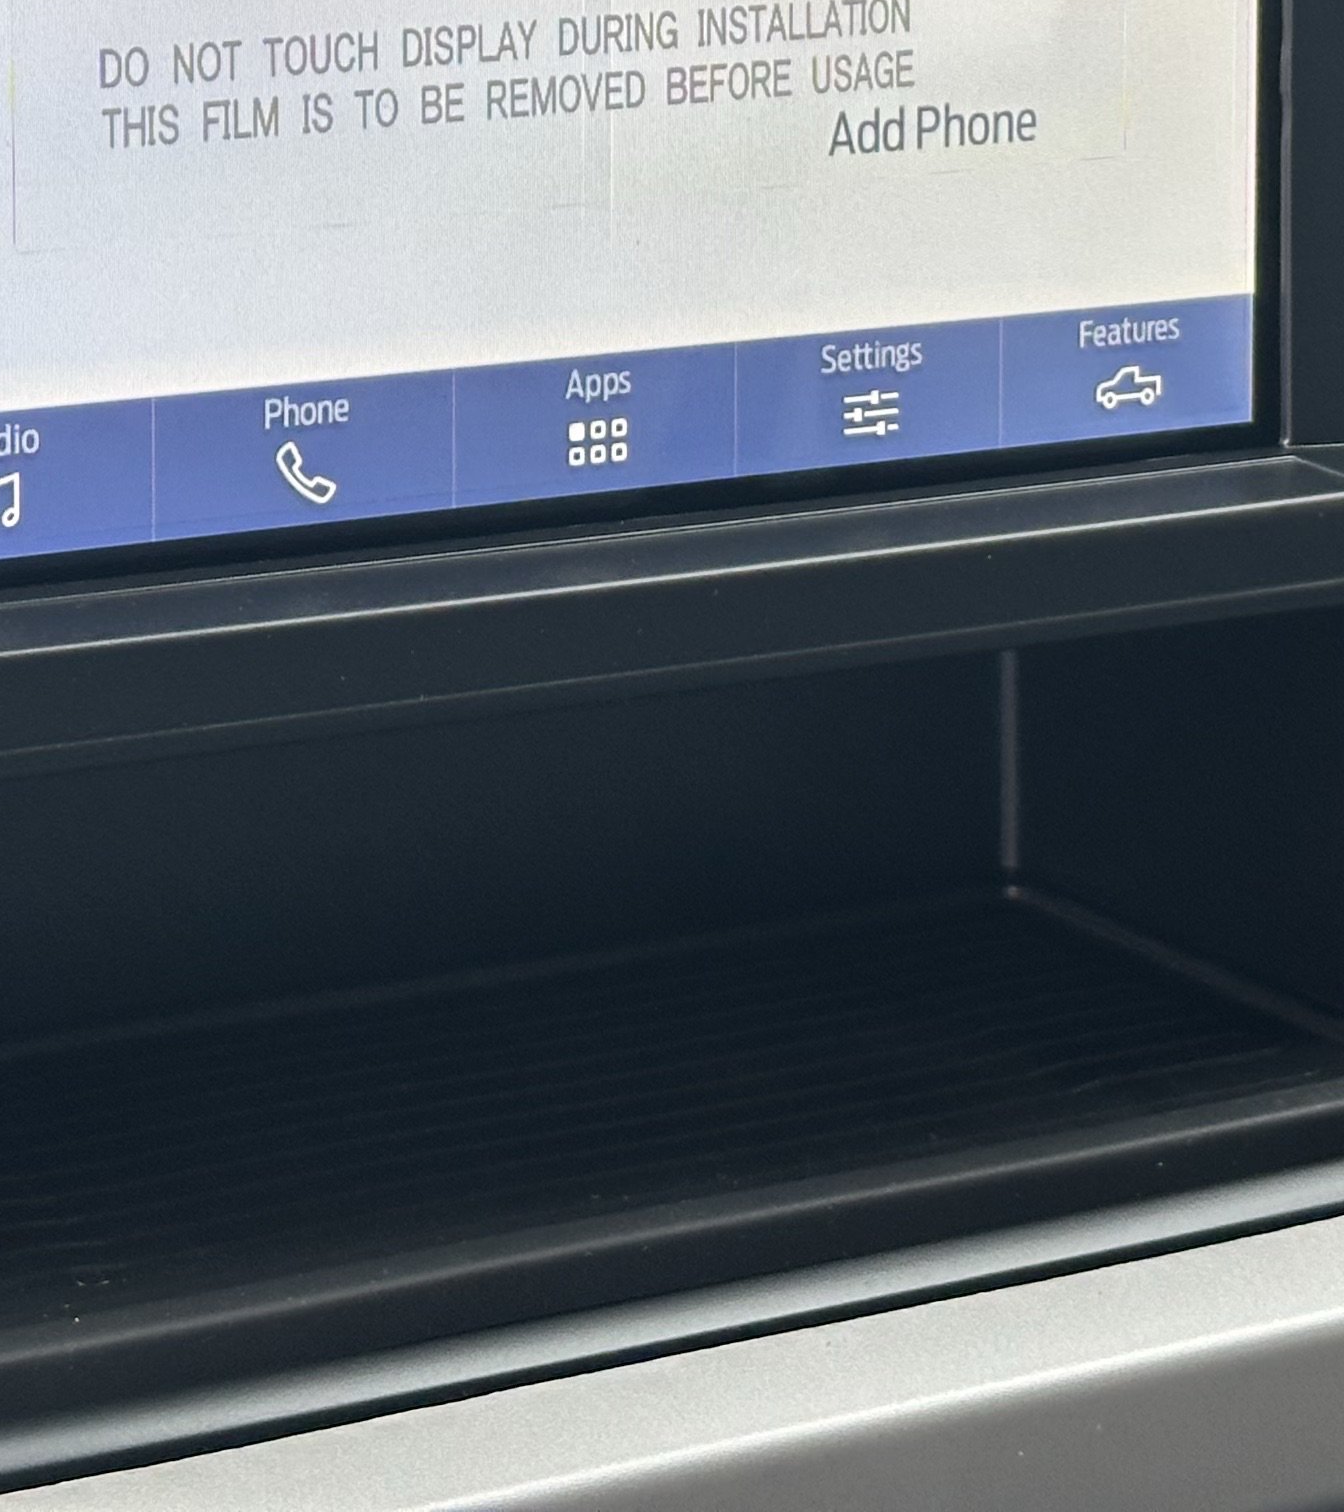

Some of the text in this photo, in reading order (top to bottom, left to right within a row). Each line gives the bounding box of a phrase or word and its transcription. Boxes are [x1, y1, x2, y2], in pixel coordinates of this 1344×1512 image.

[98, 45, 150, 89] DO
[172, 39, 243, 85] NOT
[262, 29, 379, 77] TOUCH
[402, 19, 538, 68] DISPLAY
[558, 10, 679, 57] DURING
[101, 49, 916, 150] THIS FILM IS TO BE REMOVED BEFORE USAGE
[828, 101, 1038, 157] Add Phone
[1078, 313, 1181, 349] Features
[820, 337, 924, 375] Settings
[565, 367, 632, 402] Apps
[263, 396, 351, 430] Phone
